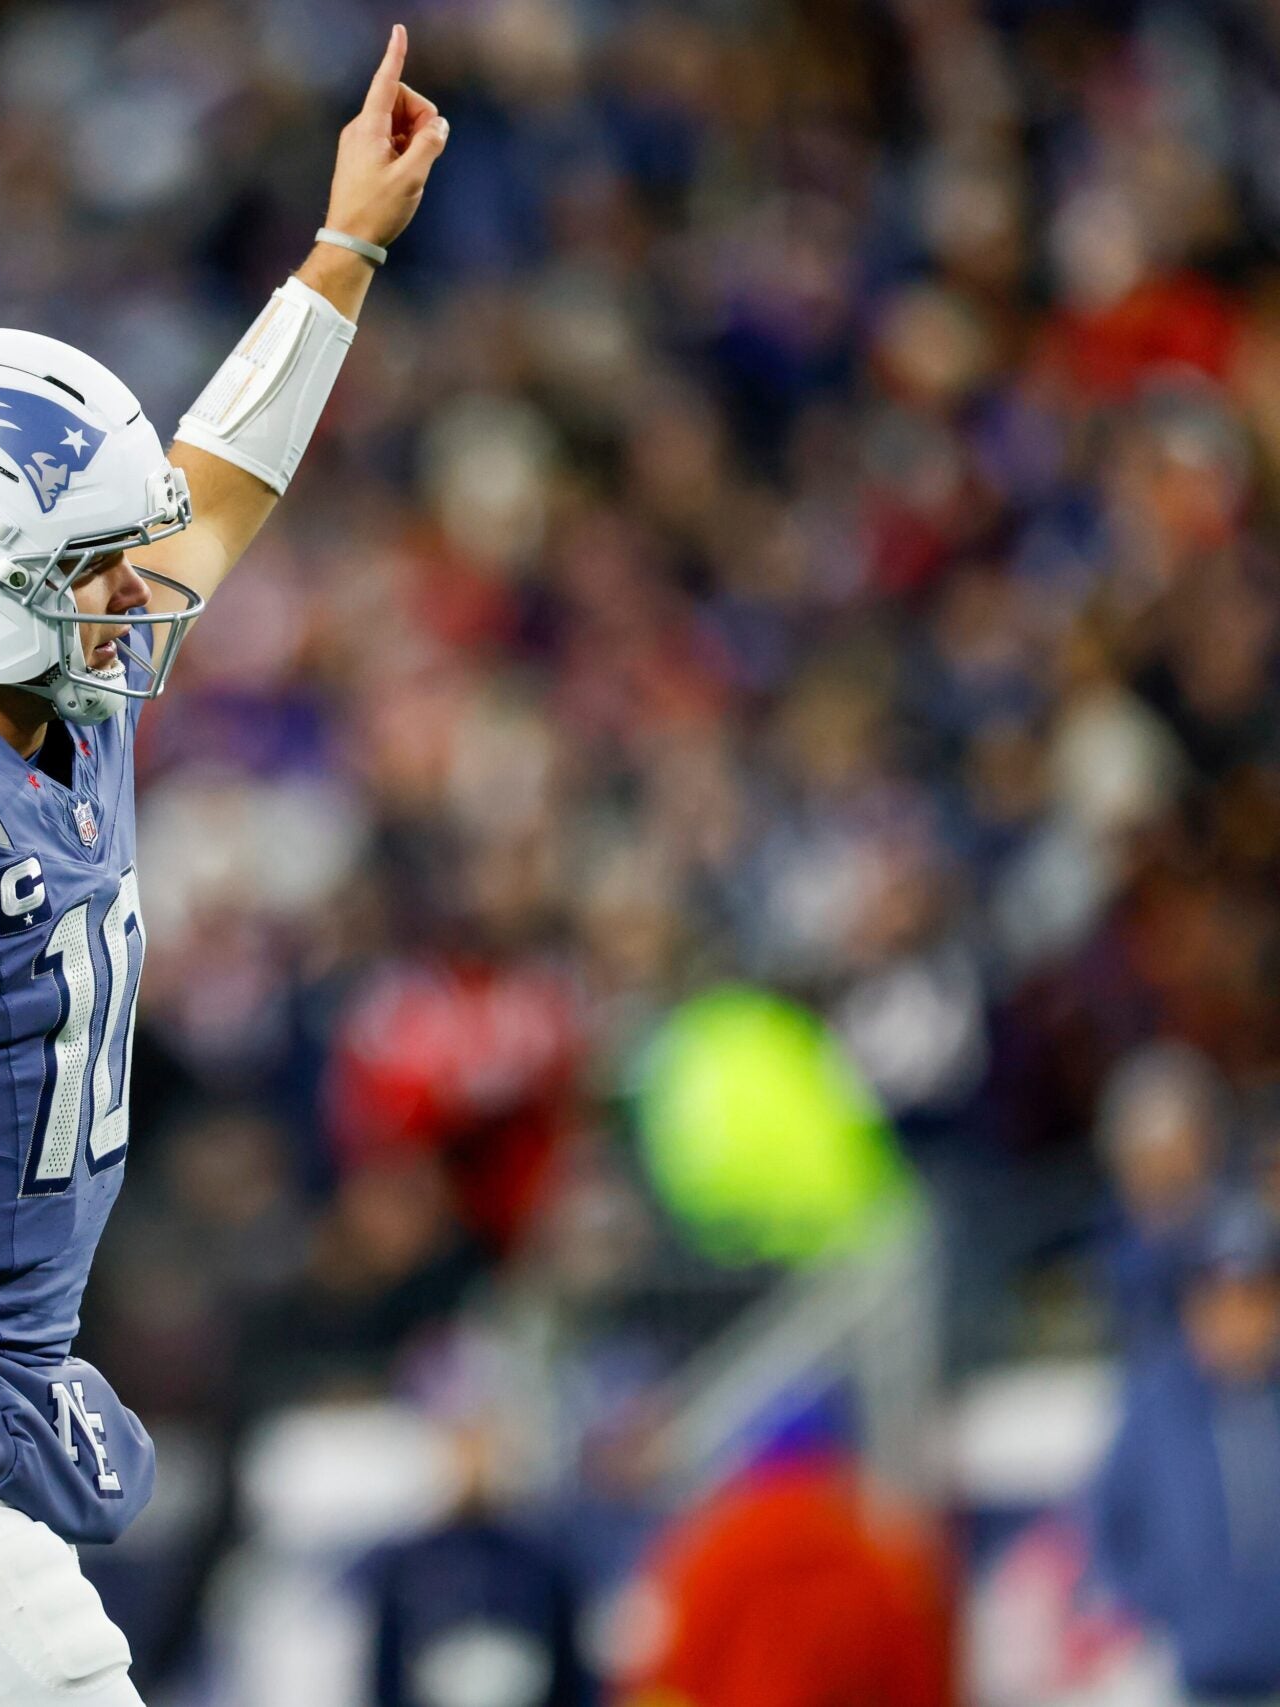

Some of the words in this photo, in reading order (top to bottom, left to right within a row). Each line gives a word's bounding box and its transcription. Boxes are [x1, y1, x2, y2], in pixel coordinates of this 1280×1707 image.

[0, 856, 46, 918] C
[20, 861, 147, 1198] 10
[49, 1380, 123, 1499] NE
